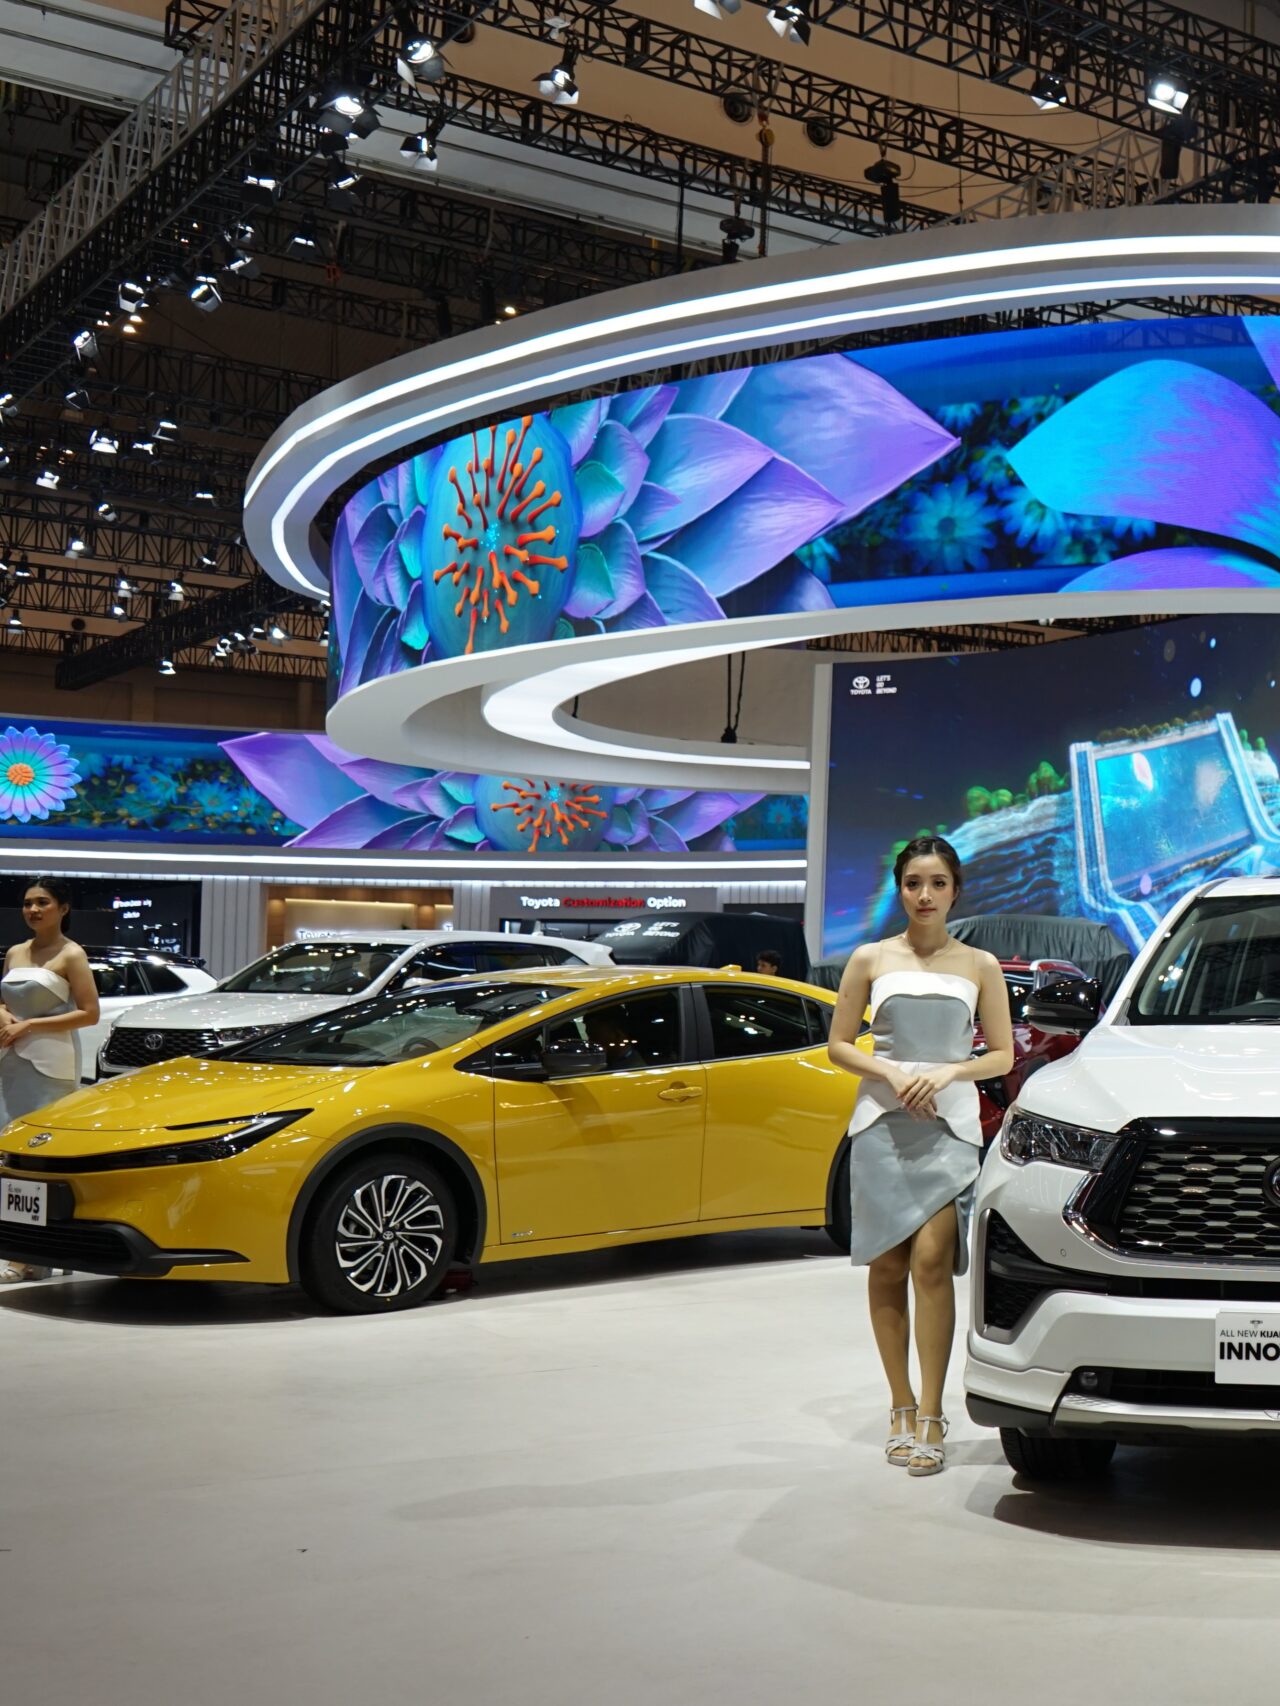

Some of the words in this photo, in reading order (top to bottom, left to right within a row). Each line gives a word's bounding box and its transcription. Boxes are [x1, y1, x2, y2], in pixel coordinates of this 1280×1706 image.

[520, 896, 560, 909] Toyota
[563, 896, 645, 908] Customization
[647, 896, 687, 909] Option
[7, 1193, 40, 1214] PRIUS
[1220, 1329, 1235, 1338] ALL
[1237, 1330, 1259, 1339] NEW
